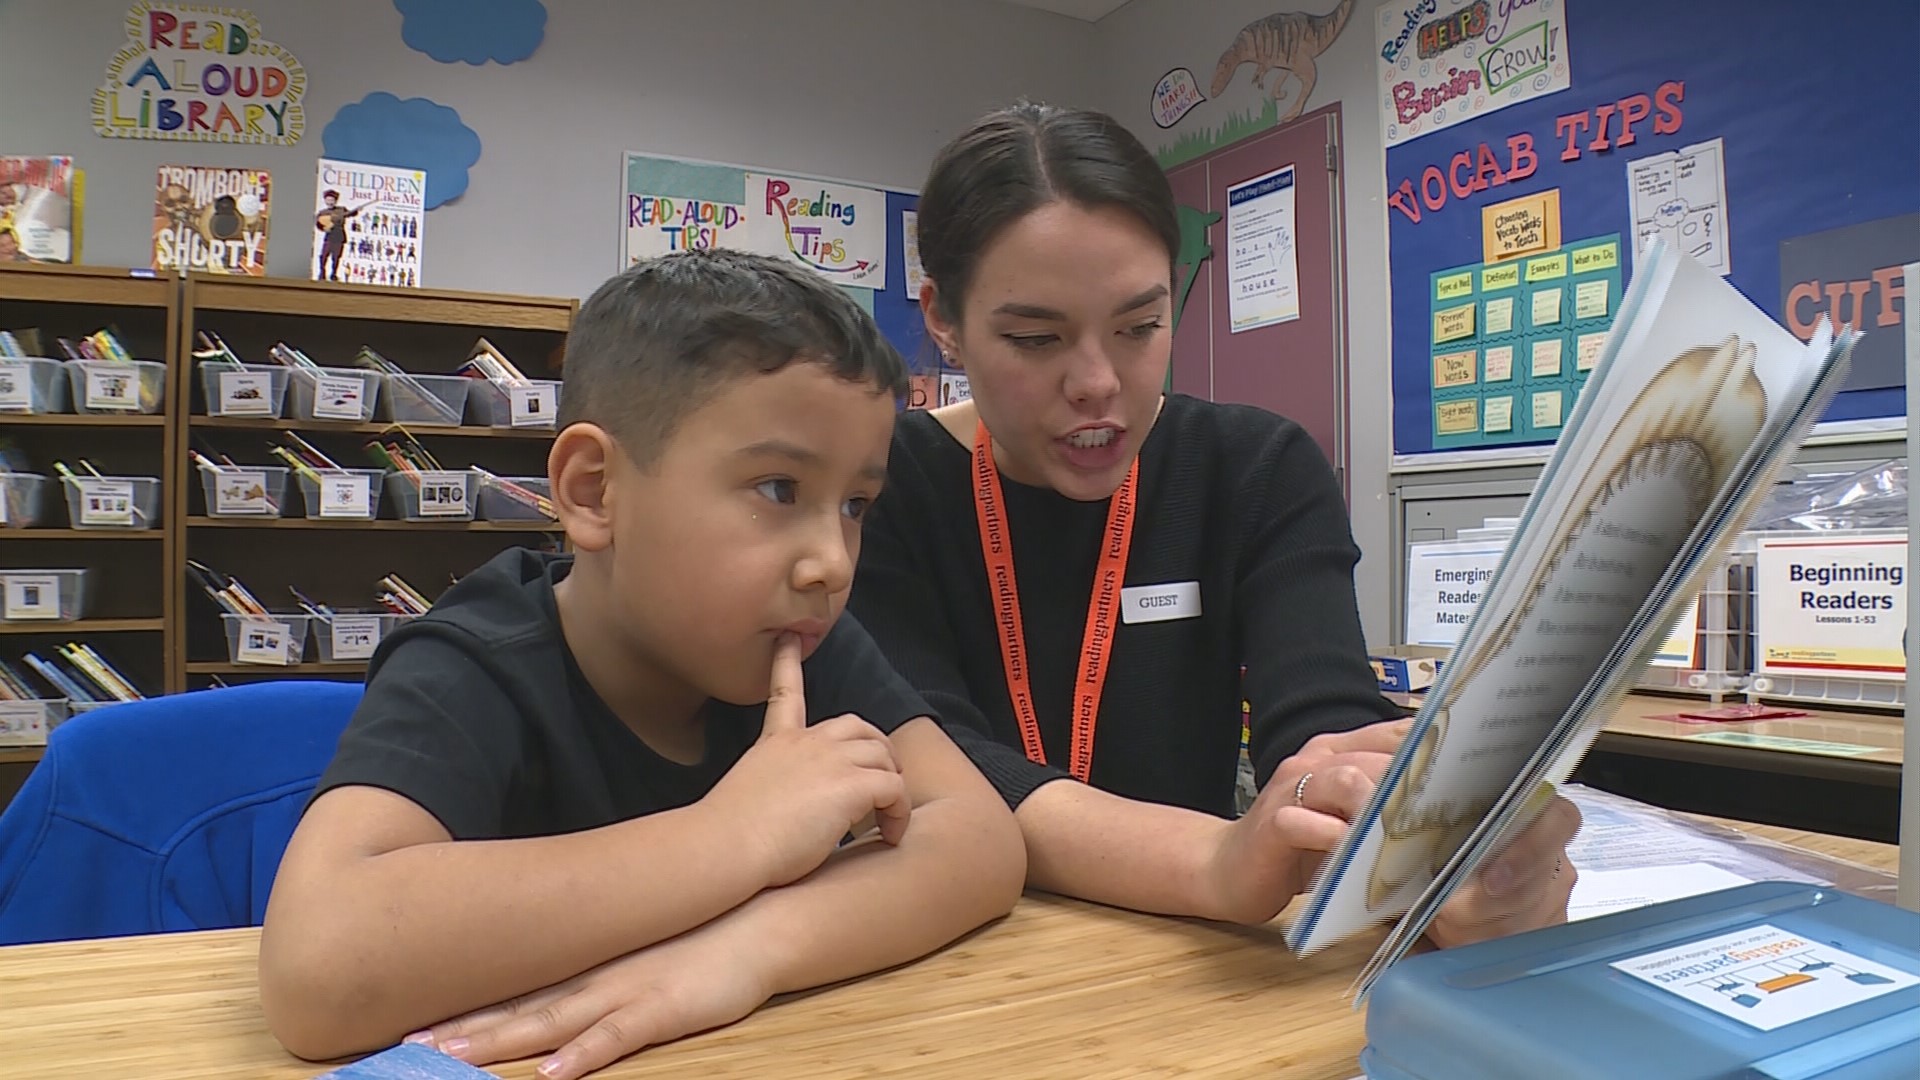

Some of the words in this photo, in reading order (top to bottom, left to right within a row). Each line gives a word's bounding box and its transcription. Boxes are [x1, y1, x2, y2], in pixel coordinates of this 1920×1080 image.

[1421, 2, 1487, 54] HELPS
[126, 56, 288, 98] ALOUD
[1157, 80, 1170, 98] WE
[1161, 83, 1186, 110] HARD
[1392, 67, 1481, 125] Brain
[1388, 132, 1540, 225] VOCAB
[1555, 81, 1686, 162] TIPS
[158, 165, 268, 210] TROMBONE
[323, 168, 422, 195] CHILDREN
[350, 188, 372, 200] Just
[375, 190, 400, 203] Like
[402, 193, 421, 206] Me
[765, 178, 856, 226] Reading
[1495, 209, 1529, 229] Choosing
[156, 221, 264, 269] SHORTY
[791, 227, 846, 263] Tips
[1514, 230, 1538, 248] Teach
[976, 443, 1003, 555] readingpartners
[1789, 562, 1904, 586] Beginning
[1138, 594, 1179, 609] GUEST
[1800, 591, 1894, 610] Readers
[1815, 614, 1852, 624] Lessons
[1854, 615, 1877, 625] 1-53
[994, 565, 1023, 681] readingpartners
[1085, 569, 1117, 684] readingpartners
[1016, 692, 1042, 763] readingp
